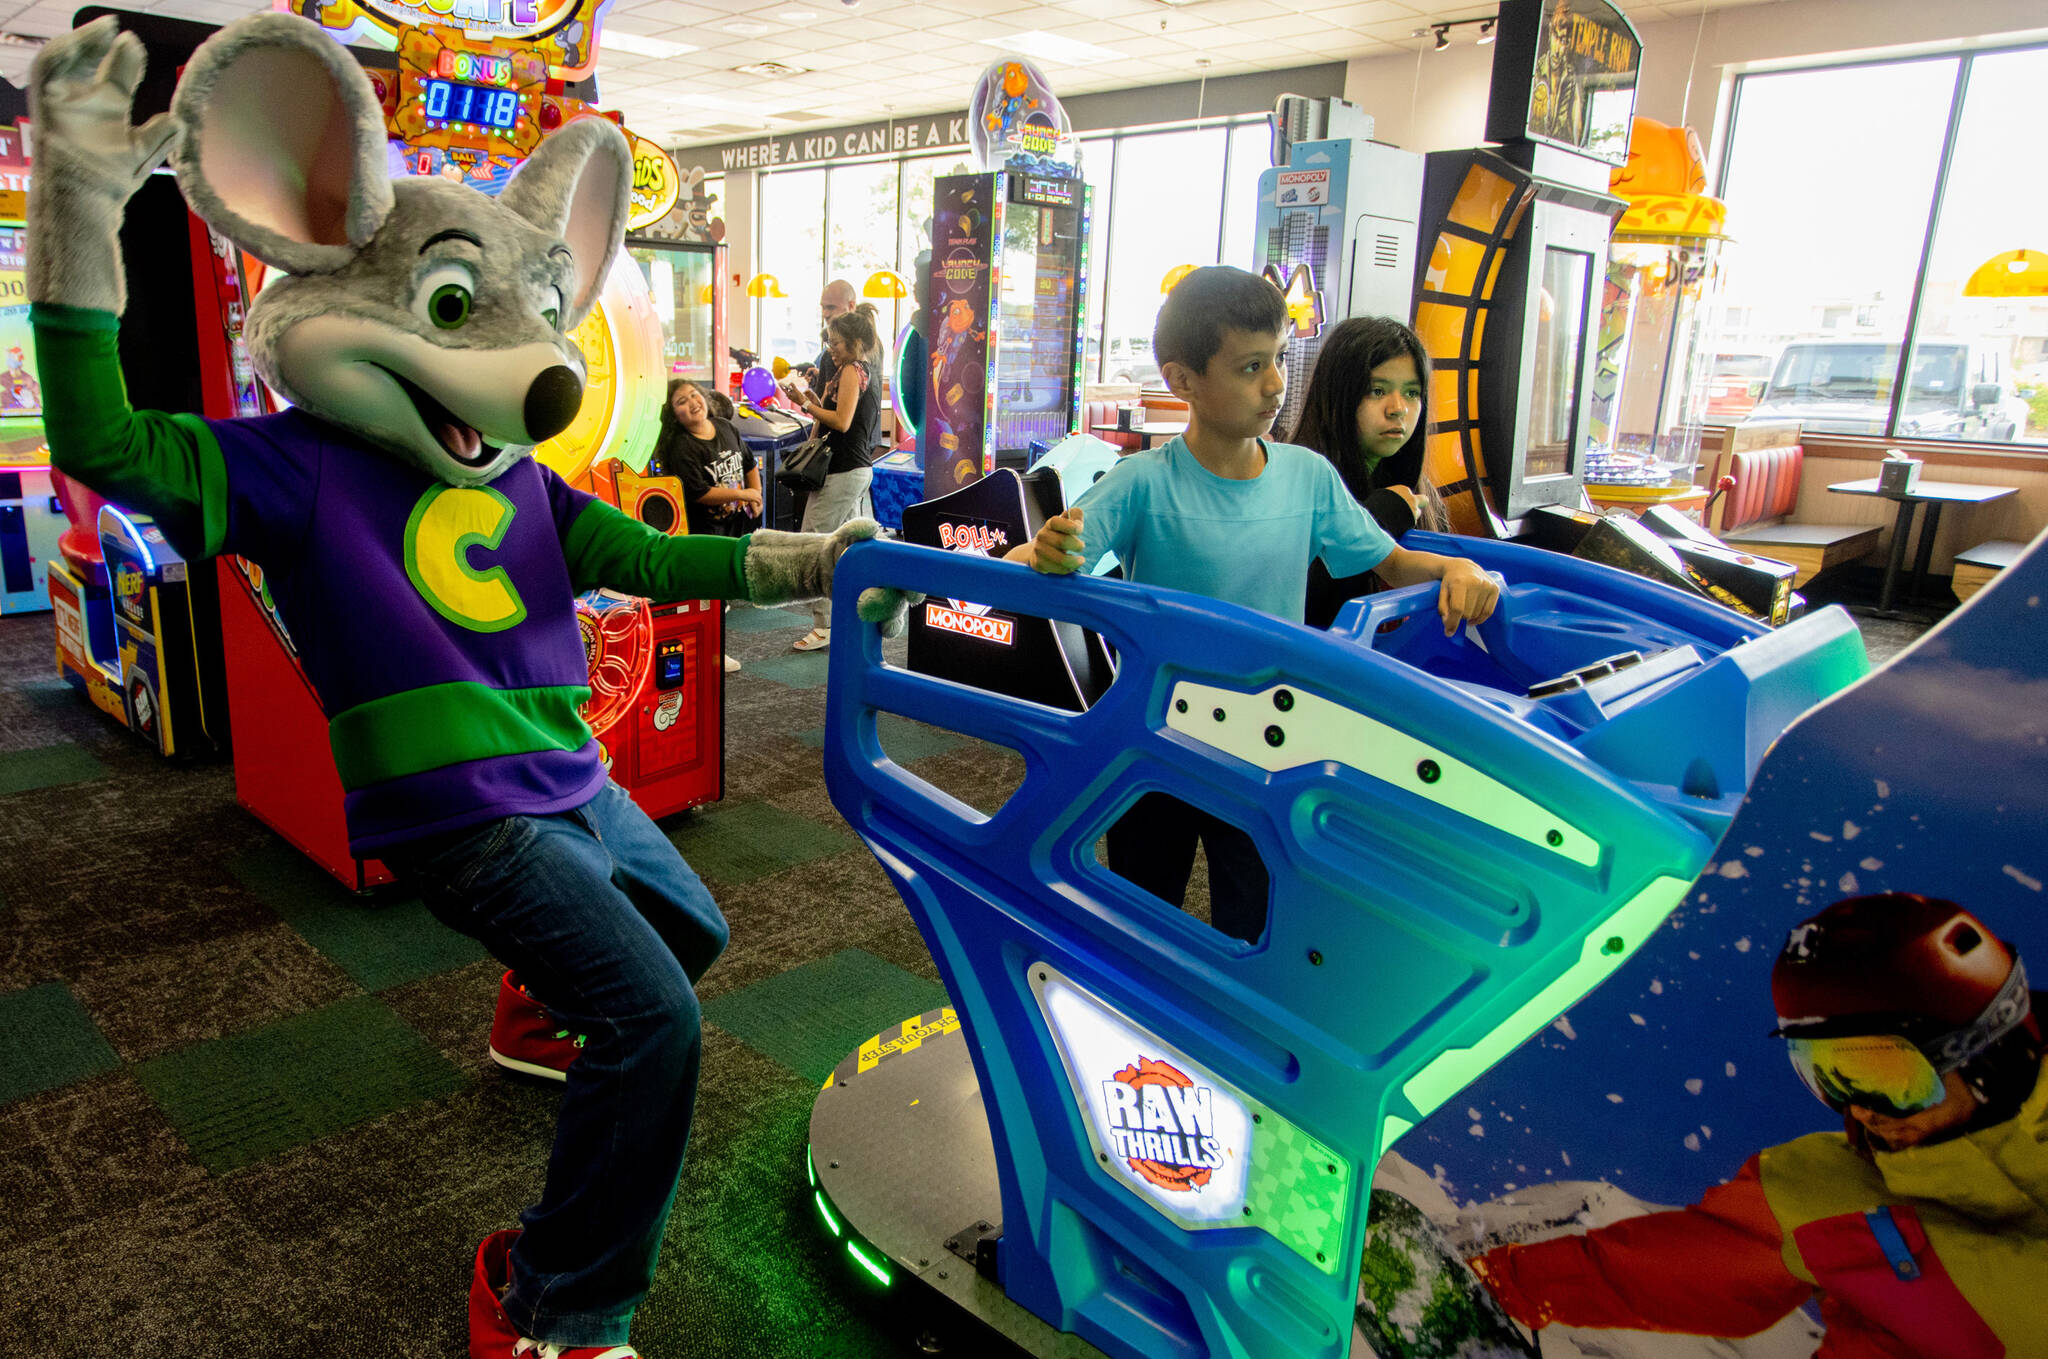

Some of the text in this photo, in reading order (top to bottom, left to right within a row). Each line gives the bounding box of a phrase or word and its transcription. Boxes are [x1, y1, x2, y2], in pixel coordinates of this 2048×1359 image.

[1570, 12, 1632, 73] TEMPLE RUN
[436, 49, 513, 87] BONUS
[426, 81, 517, 127] 0118
[451, 151, 477, 163] BALL
[722, 117, 970, 169] WHERE A KID CAN BE A KI
[1022, 134, 1057, 155] CODE
[1281, 172, 1326, 184] MONOPOLY
[945, 268, 976, 280] CODE
[938, 522, 995, 551] ROLL
[403, 480, 527, 633] C
[116, 569, 144, 597] NERF
[928, 607, 1009, 641] MONOPOLY
[900, 1026, 937, 1047] YOUR
[861, 1042, 897, 1063] STEP
[1102, 1079, 1214, 1138] RAW
[1110, 1127, 1224, 1170] THRILLS
